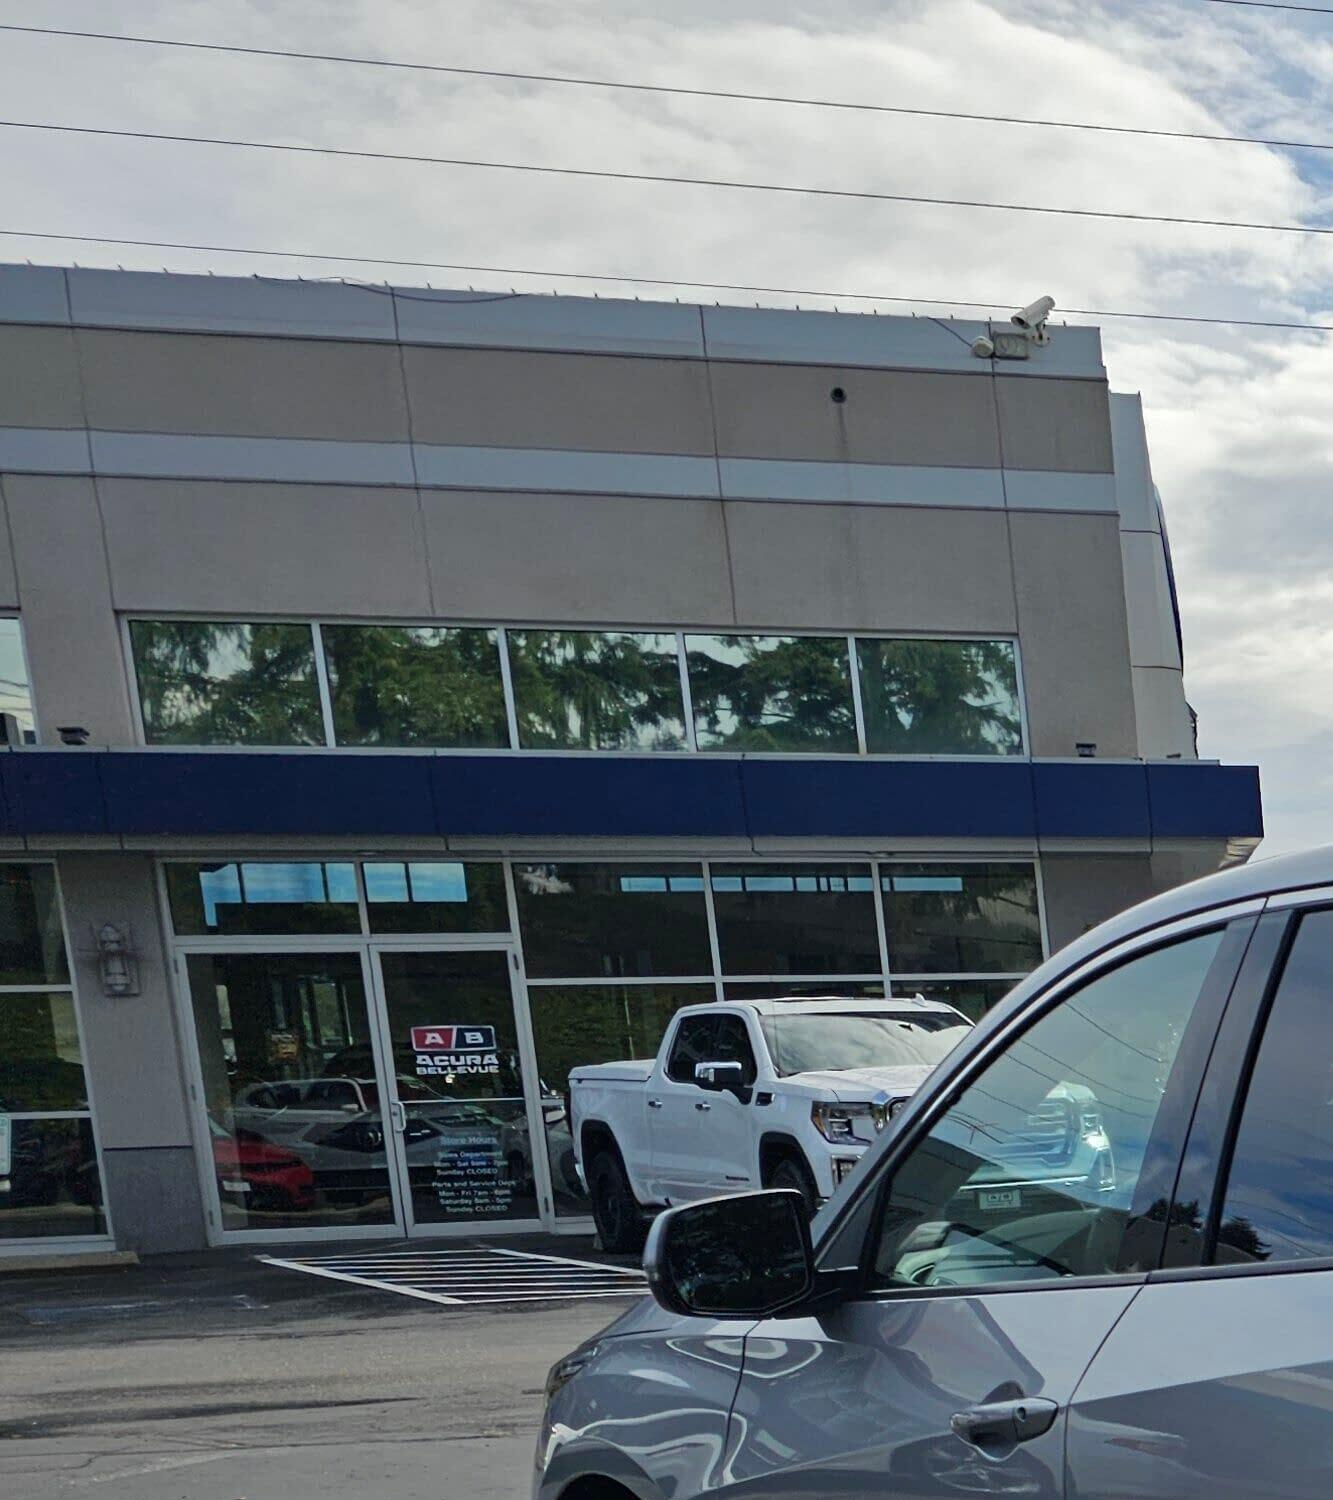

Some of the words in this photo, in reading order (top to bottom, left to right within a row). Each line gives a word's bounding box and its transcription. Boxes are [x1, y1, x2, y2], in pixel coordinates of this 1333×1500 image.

[424, 1032, 445, 1045] A
[463, 1031, 484, 1044] B
[416, 1053, 499, 1066] ACURA
[416, 1065, 499, 1075] BELLEVUE
